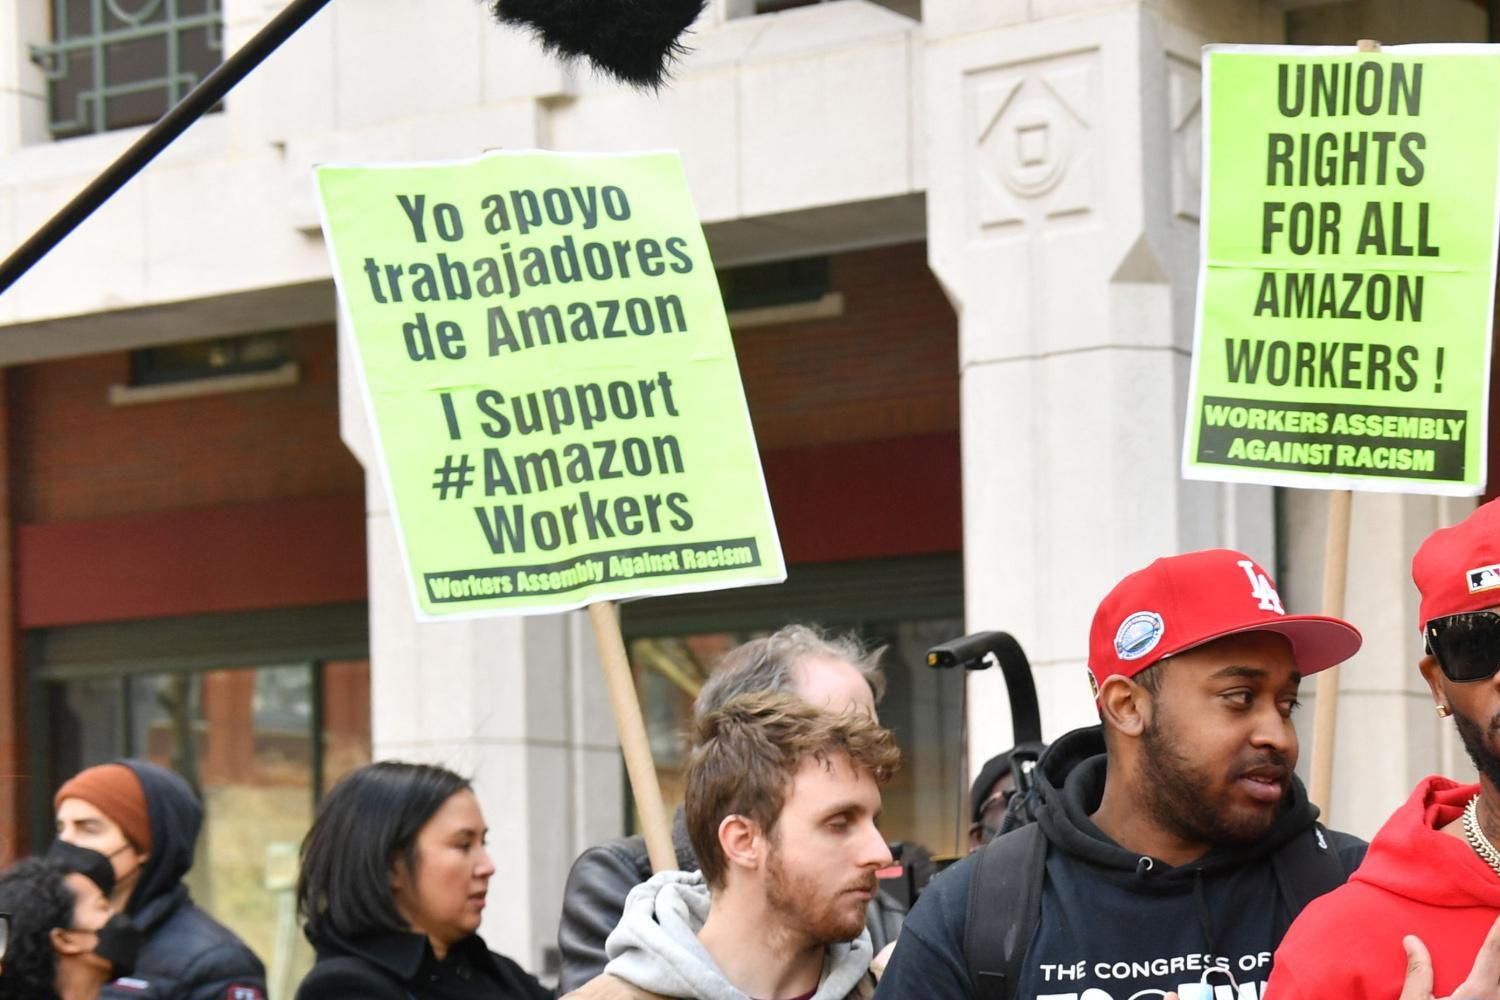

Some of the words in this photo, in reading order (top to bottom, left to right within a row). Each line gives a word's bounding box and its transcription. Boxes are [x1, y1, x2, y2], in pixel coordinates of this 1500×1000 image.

[1277, 61, 1424, 117] UNION
[1265, 131, 1427, 187] RIGHTS
[396, 193, 464, 243] Yo
[480, 183, 632, 235] apoyo
[1261, 201, 1341, 255] FOR
[1356, 201, 1440, 258] ALL
[363, 233, 694, 305] trabajadores
[1252, 272, 1425, 323] AMAZON
[402, 312, 467, 362] de
[487, 291, 688, 357] Amazon
[1225, 337, 1420, 394] WORKERS
[439, 392, 462, 441] I
[475, 371, 681, 438] Support
[1203, 403, 1329, 436] WORKERS
[1331, 412, 1465, 442] ASSEMBLY
[431, 432, 686, 501] #Amazon
[1227, 437, 1333, 468] AGAINST
[1334, 444, 1436, 472] RACISM
[473, 490, 694, 555] Workers
[428, 576, 513, 600] Workers
[516, 558, 605, 592] Assembly
[609, 551, 679, 578] Against
[681, 545, 753, 569] Racism
[1237, 560, 1286, 615] LA
[1040, 960, 1087, 981] THE
[1238, 951, 1272, 972] OF
